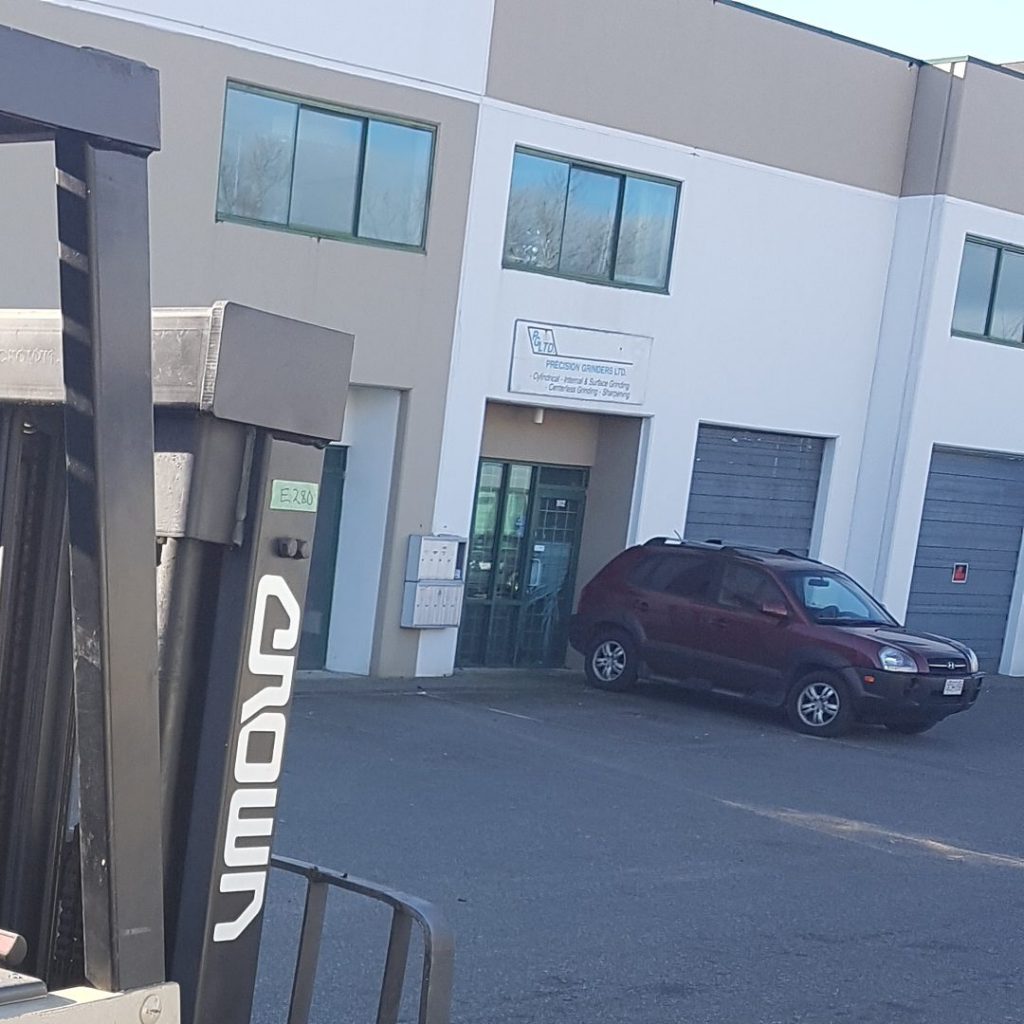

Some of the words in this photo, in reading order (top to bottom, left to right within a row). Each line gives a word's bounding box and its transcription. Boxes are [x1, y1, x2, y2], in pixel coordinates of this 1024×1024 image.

[545, 360, 580, 372] PRECISION
[581, 363, 613, 375] GRINDERS
[532, 372, 560, 383] Cylindrical
[564, 376, 583, 385] Internal
[589, 377, 608, 387] Surface
[608, 379, 631, 391] Grinding
[577, 386, 598, 397] Grinding
[602, 388, 631, 400] Sharpening
[280, 487, 314, 506] E280
[213, 573, 301, 943] CROWN
